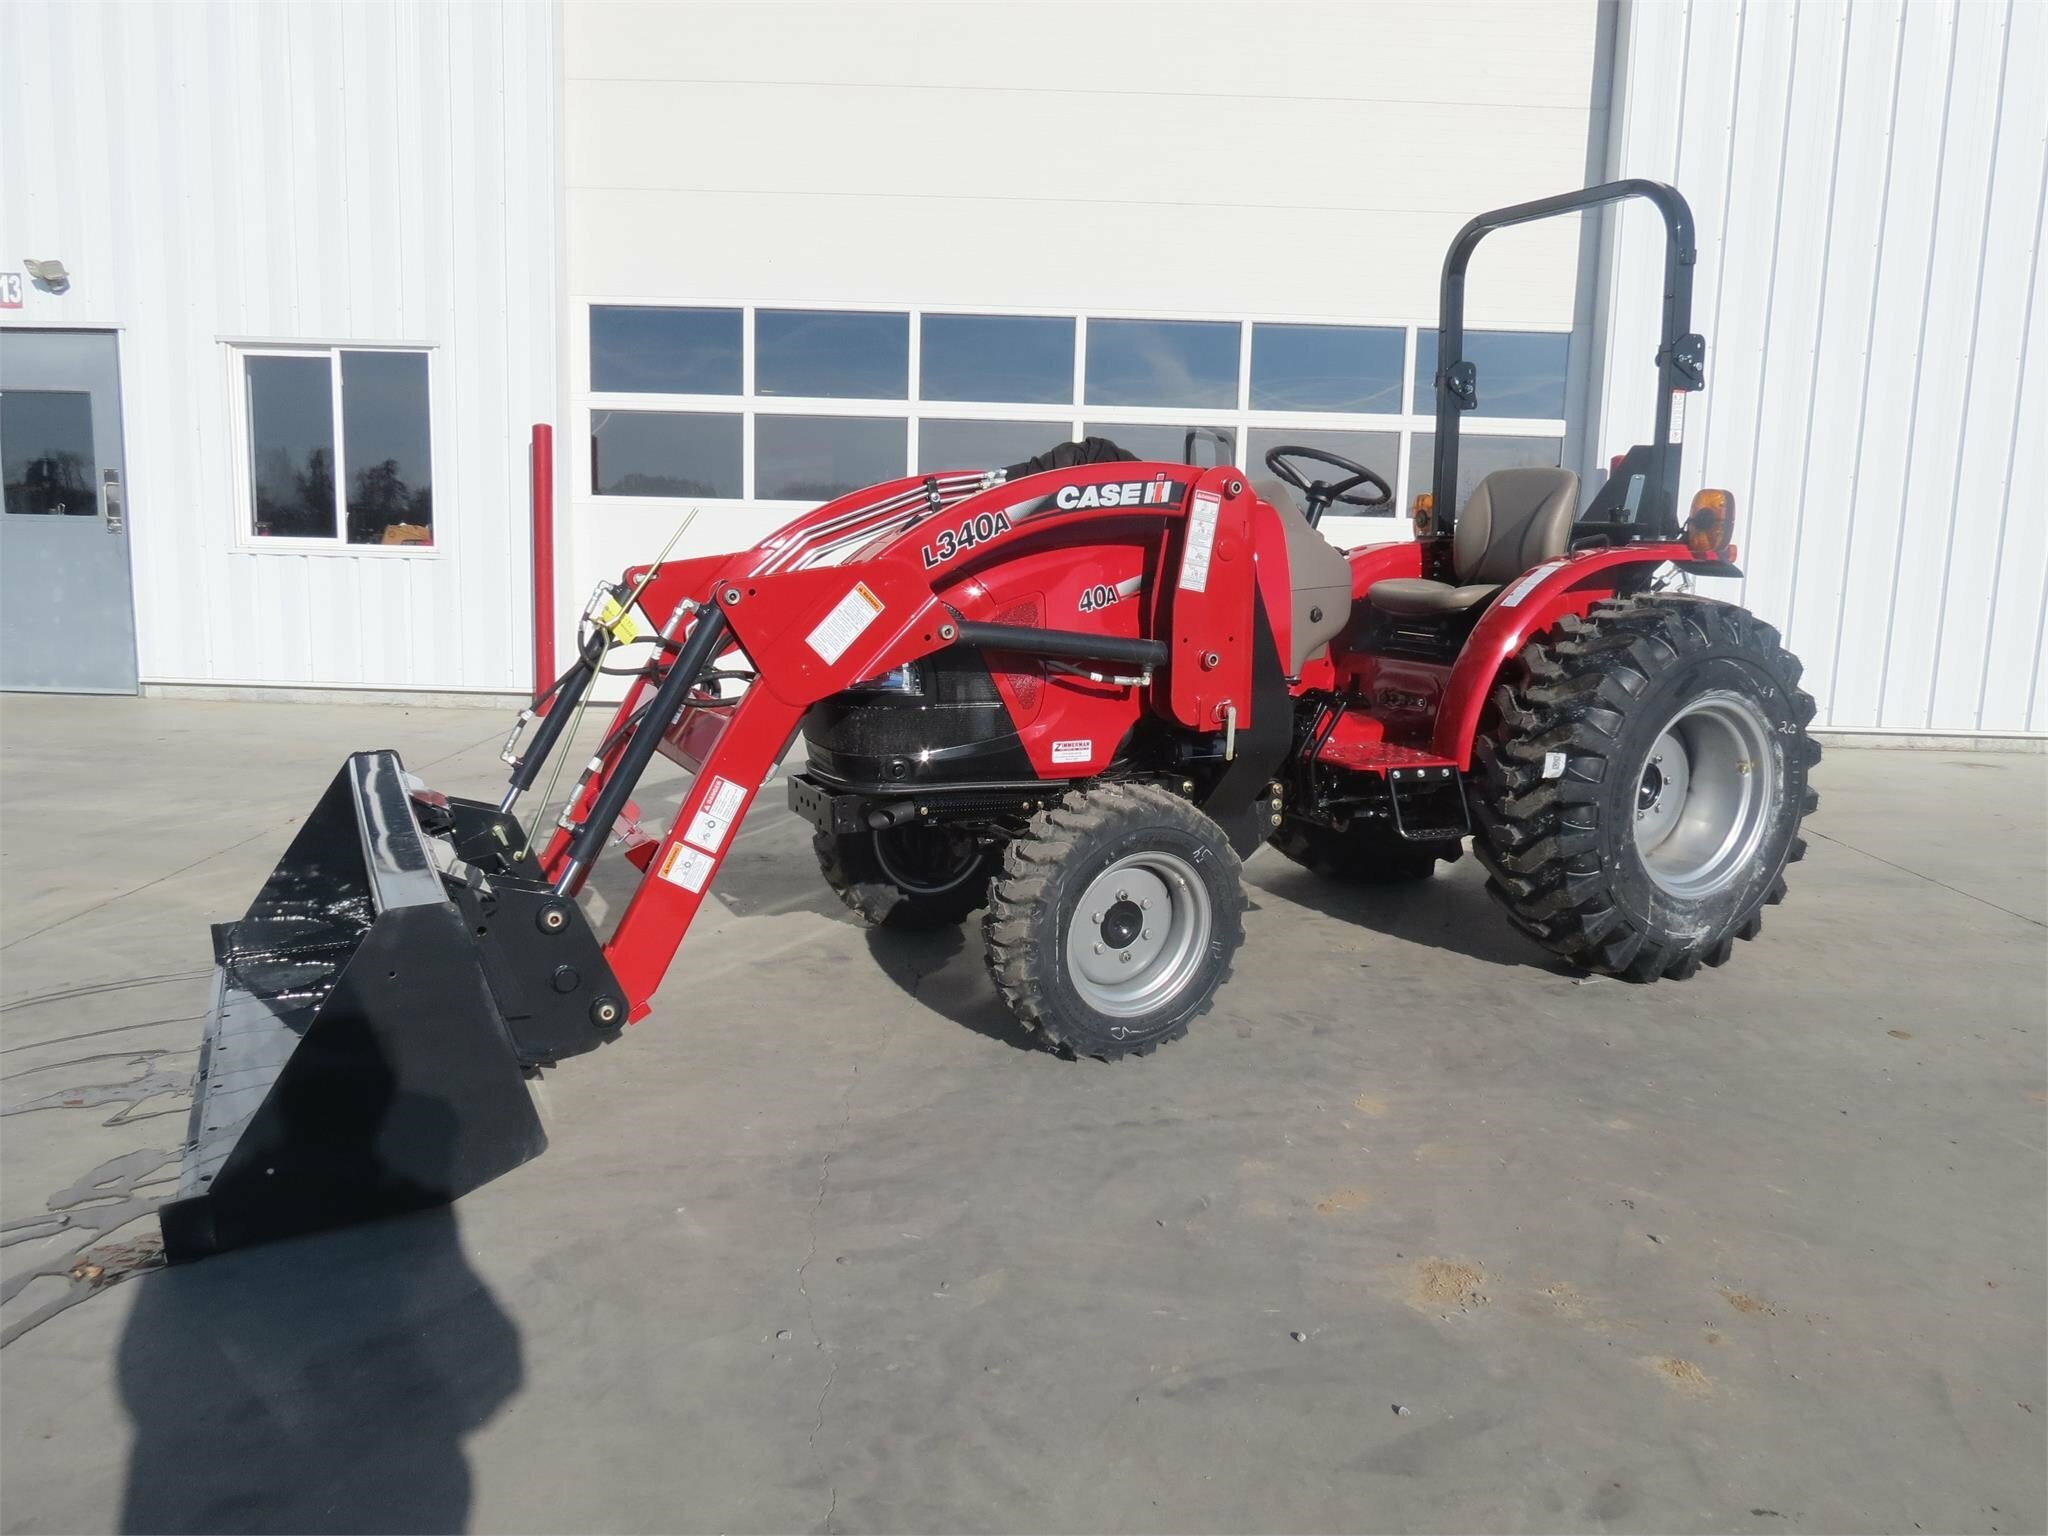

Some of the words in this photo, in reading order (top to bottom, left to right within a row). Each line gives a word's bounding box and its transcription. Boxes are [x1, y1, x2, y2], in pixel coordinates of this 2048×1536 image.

[1056, 484, 1142, 510] CASE
[922, 511, 1012, 569] L340A
[1079, 585, 1117, 612] 40A
[706, 780, 723, 806] DANGER
